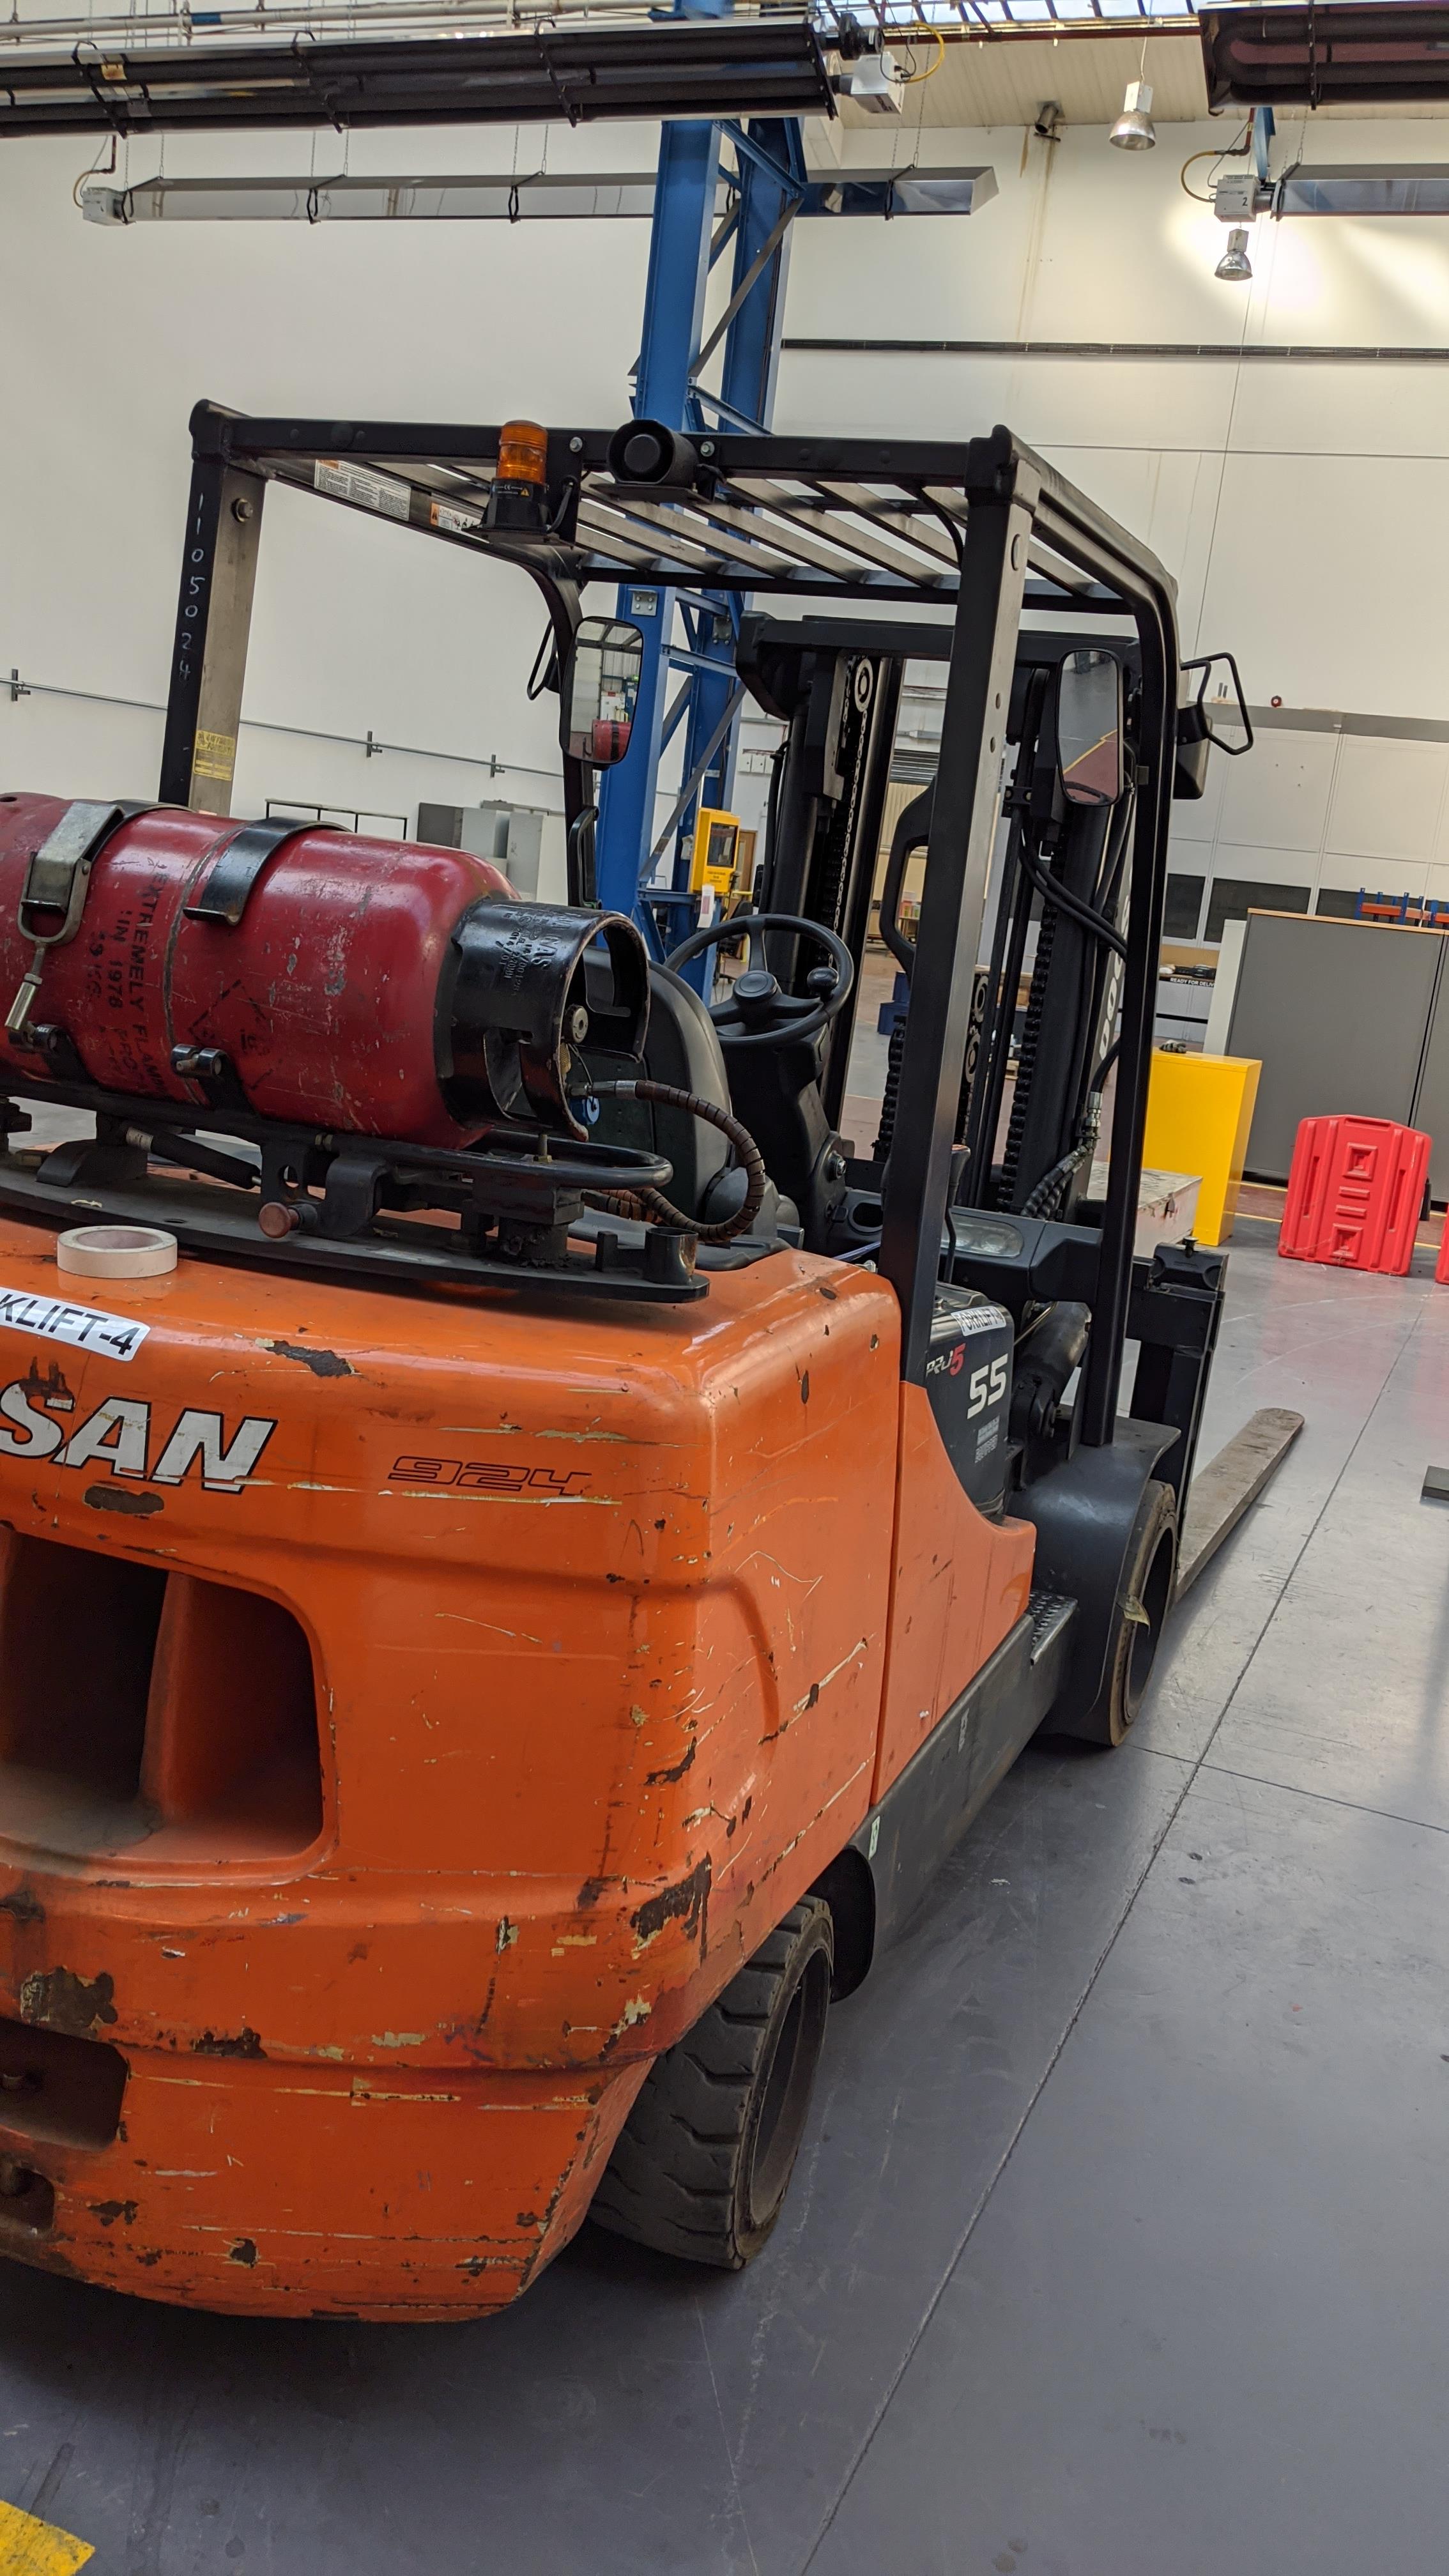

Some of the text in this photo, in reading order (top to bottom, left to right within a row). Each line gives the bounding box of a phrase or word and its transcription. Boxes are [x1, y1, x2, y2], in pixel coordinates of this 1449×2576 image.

[1241, 197, 1248, 206] 2
[107, 960, 123, 1008] 1978
[967, 1353, 1009, 1420] 55
[0, 1379, 280, 1495] SAN
[387, 1455, 592, 1496] 924
